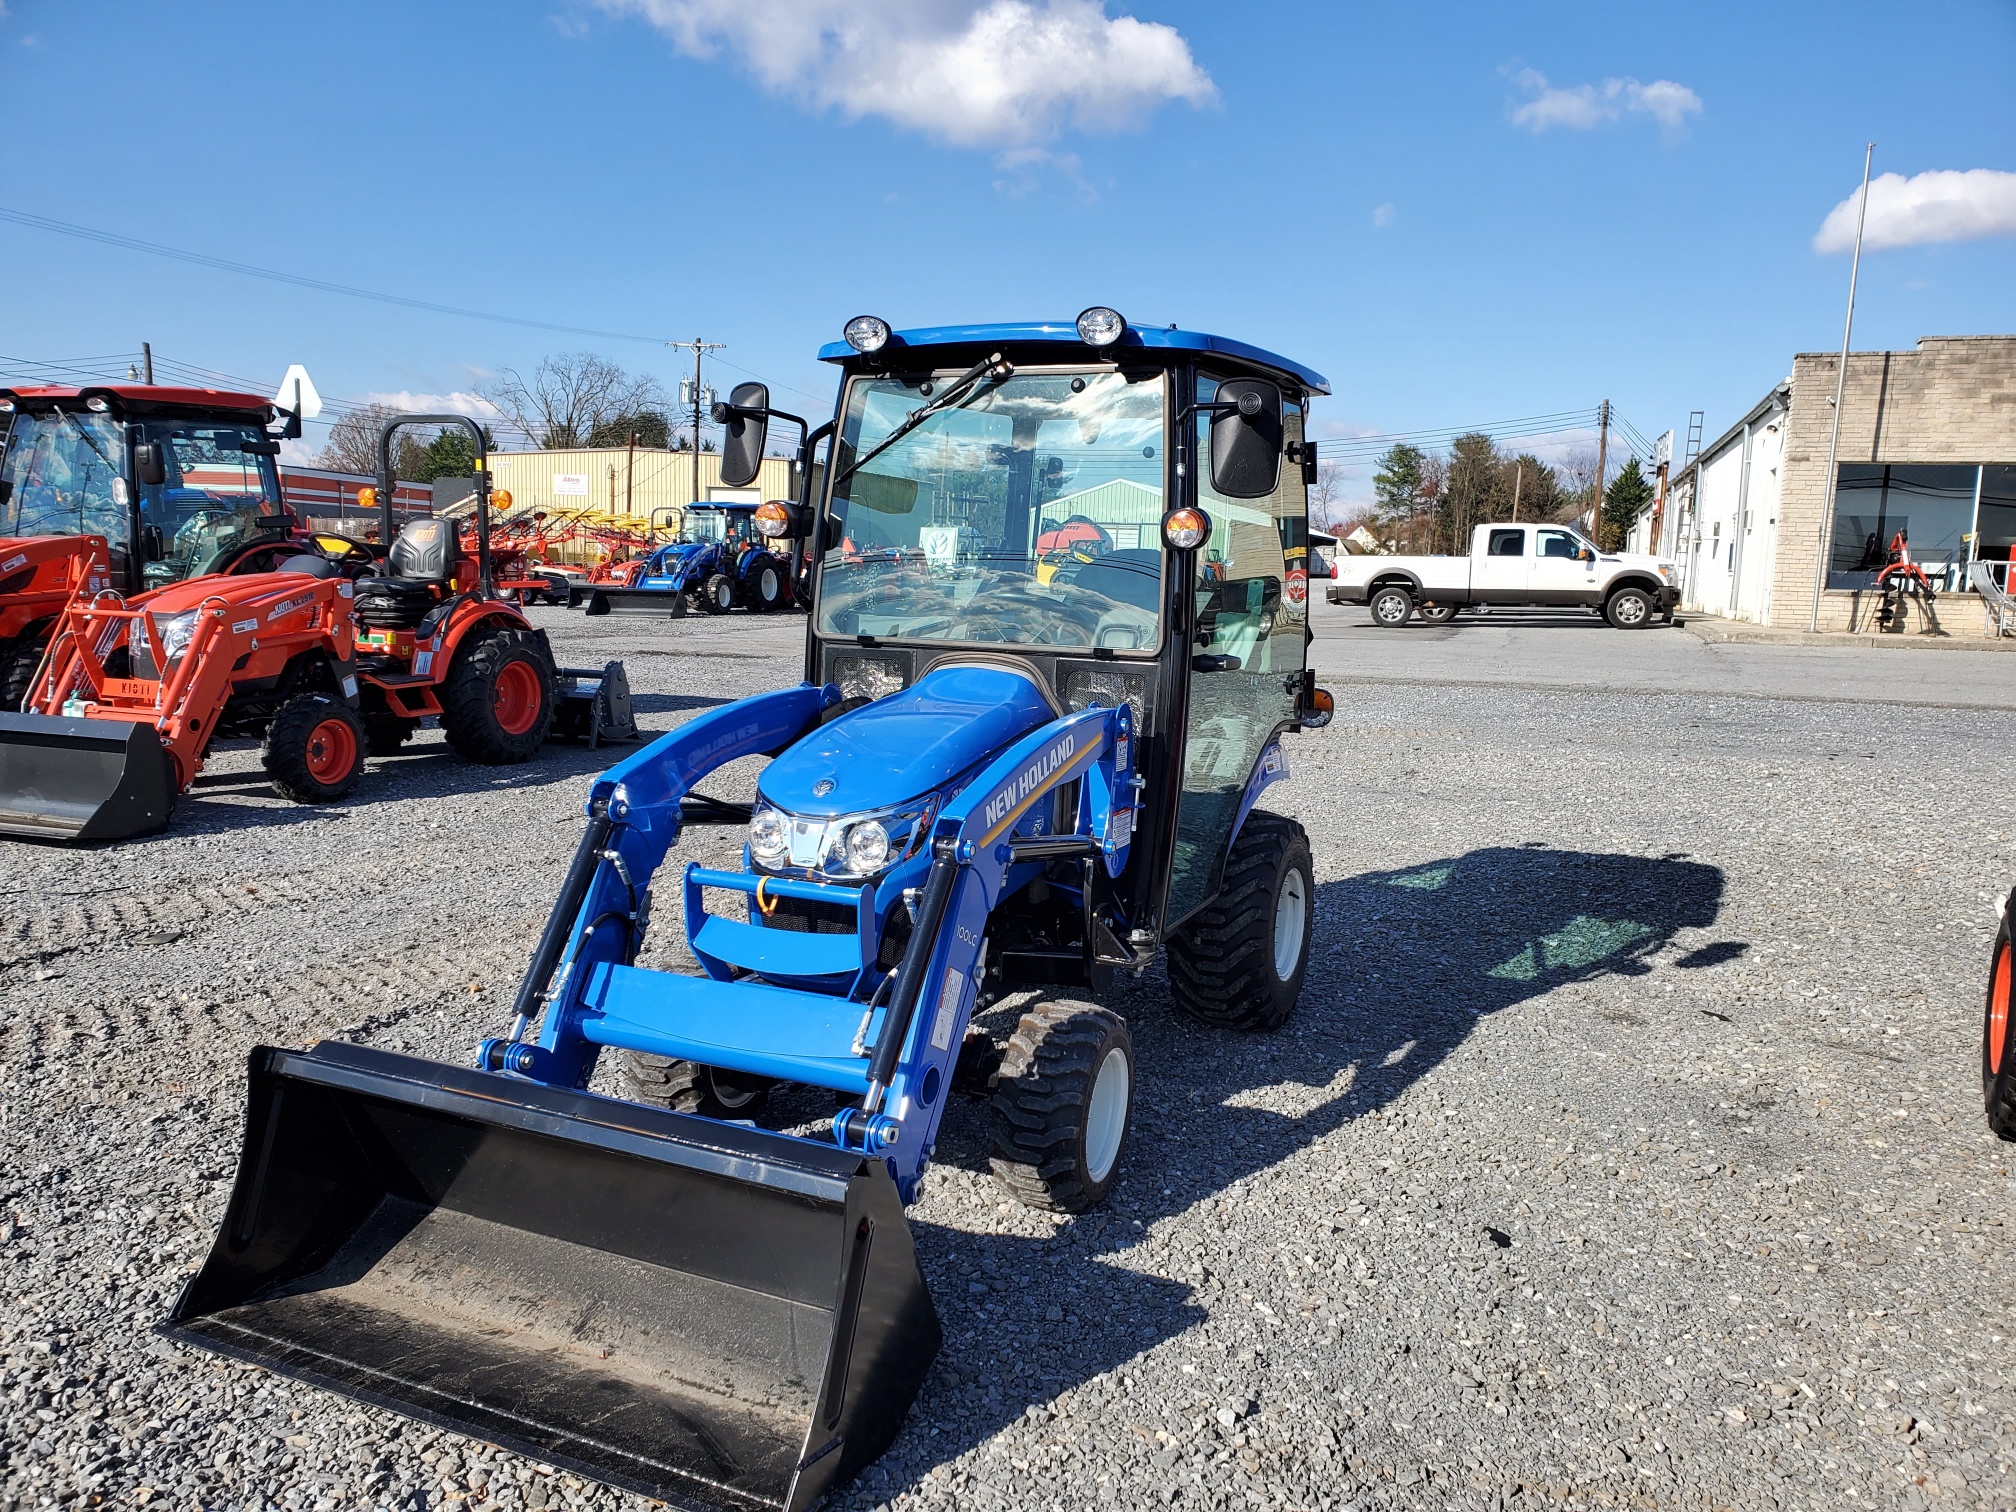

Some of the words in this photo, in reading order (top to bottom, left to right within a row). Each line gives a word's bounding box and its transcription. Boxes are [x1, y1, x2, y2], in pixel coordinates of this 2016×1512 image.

[121, 682, 150, 696] KIOTI
[985, 781, 1017, 829] NEW
[1018, 734, 1075, 800] HOLLAND
[956, 924, 978, 947] 100LC
